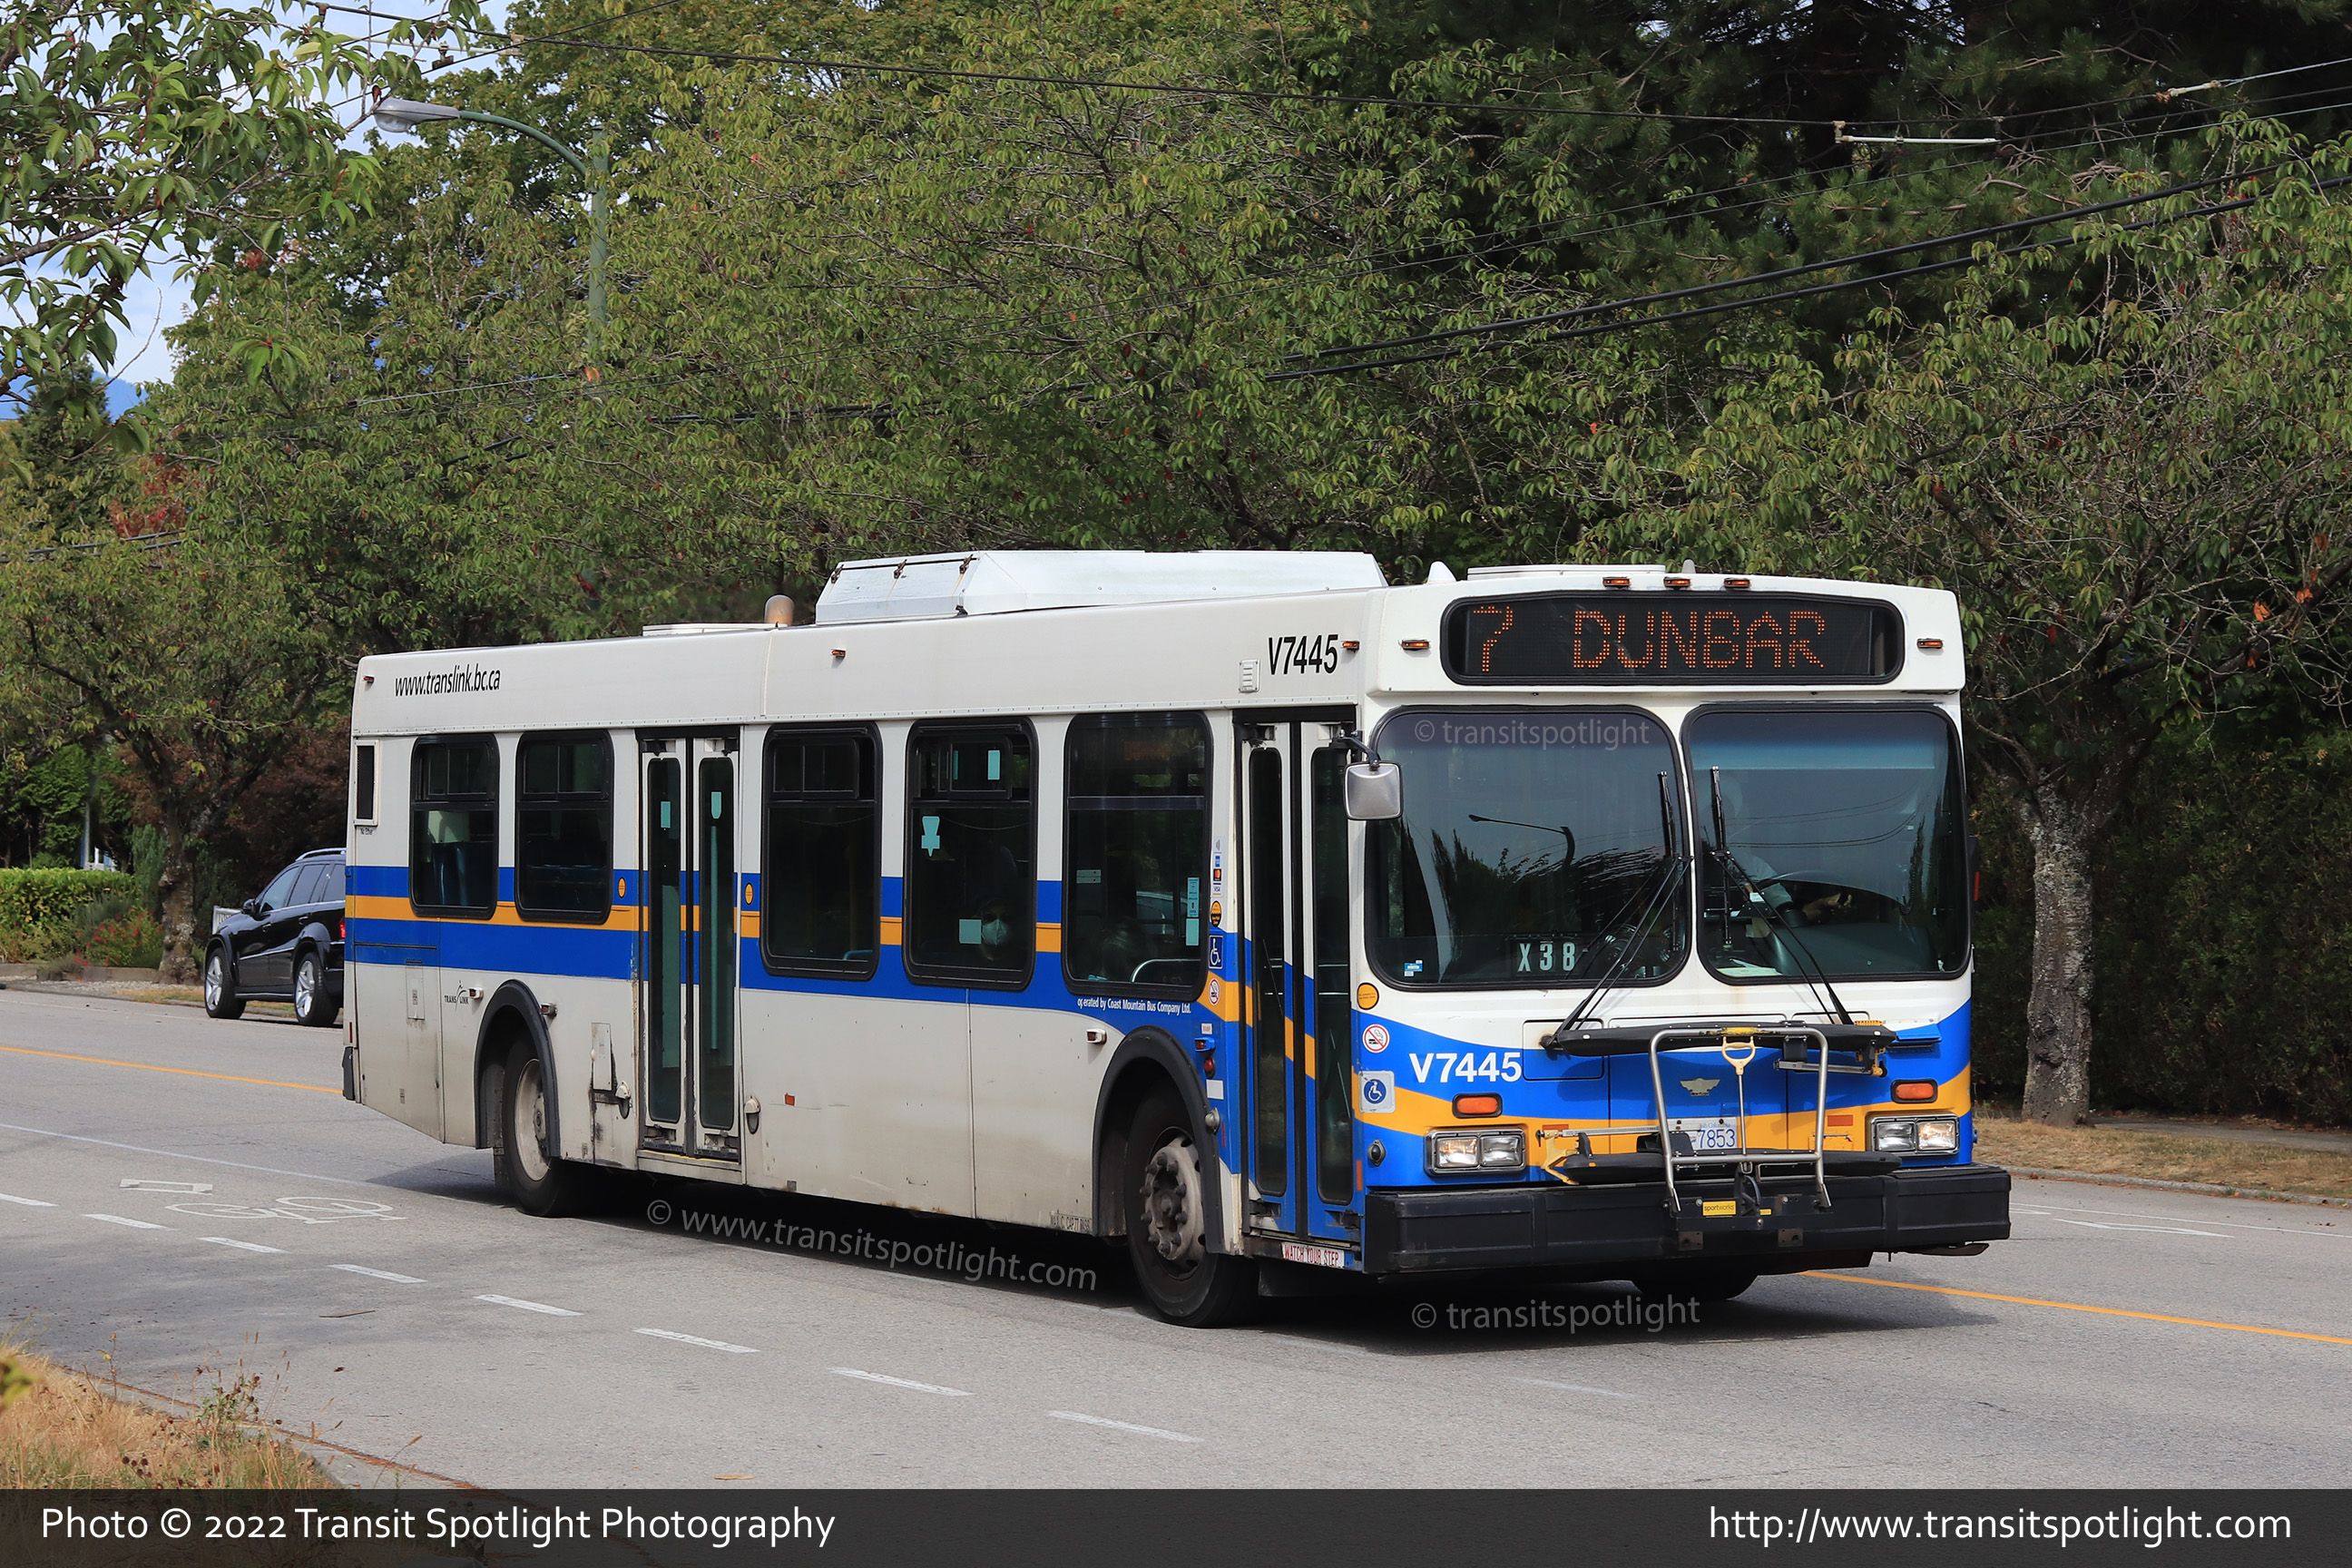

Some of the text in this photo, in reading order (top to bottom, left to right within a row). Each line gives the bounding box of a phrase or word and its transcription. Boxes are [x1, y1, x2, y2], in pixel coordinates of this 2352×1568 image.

[1473, 605, 1825, 671] 7 DUNBAR
[1269, 633, 1338, 675] V7445
[395, 663, 501, 697] www.translink.bc.ca
[1077, 996, 1191, 1015] operated by Coast Mountain Bus Company Ltd.
[1409, 1053, 1522, 1083] V7445
[1700, 1128, 1735, 1149] 7853
[1285, 1244, 1338, 1267] WATCH YOUR STEP
